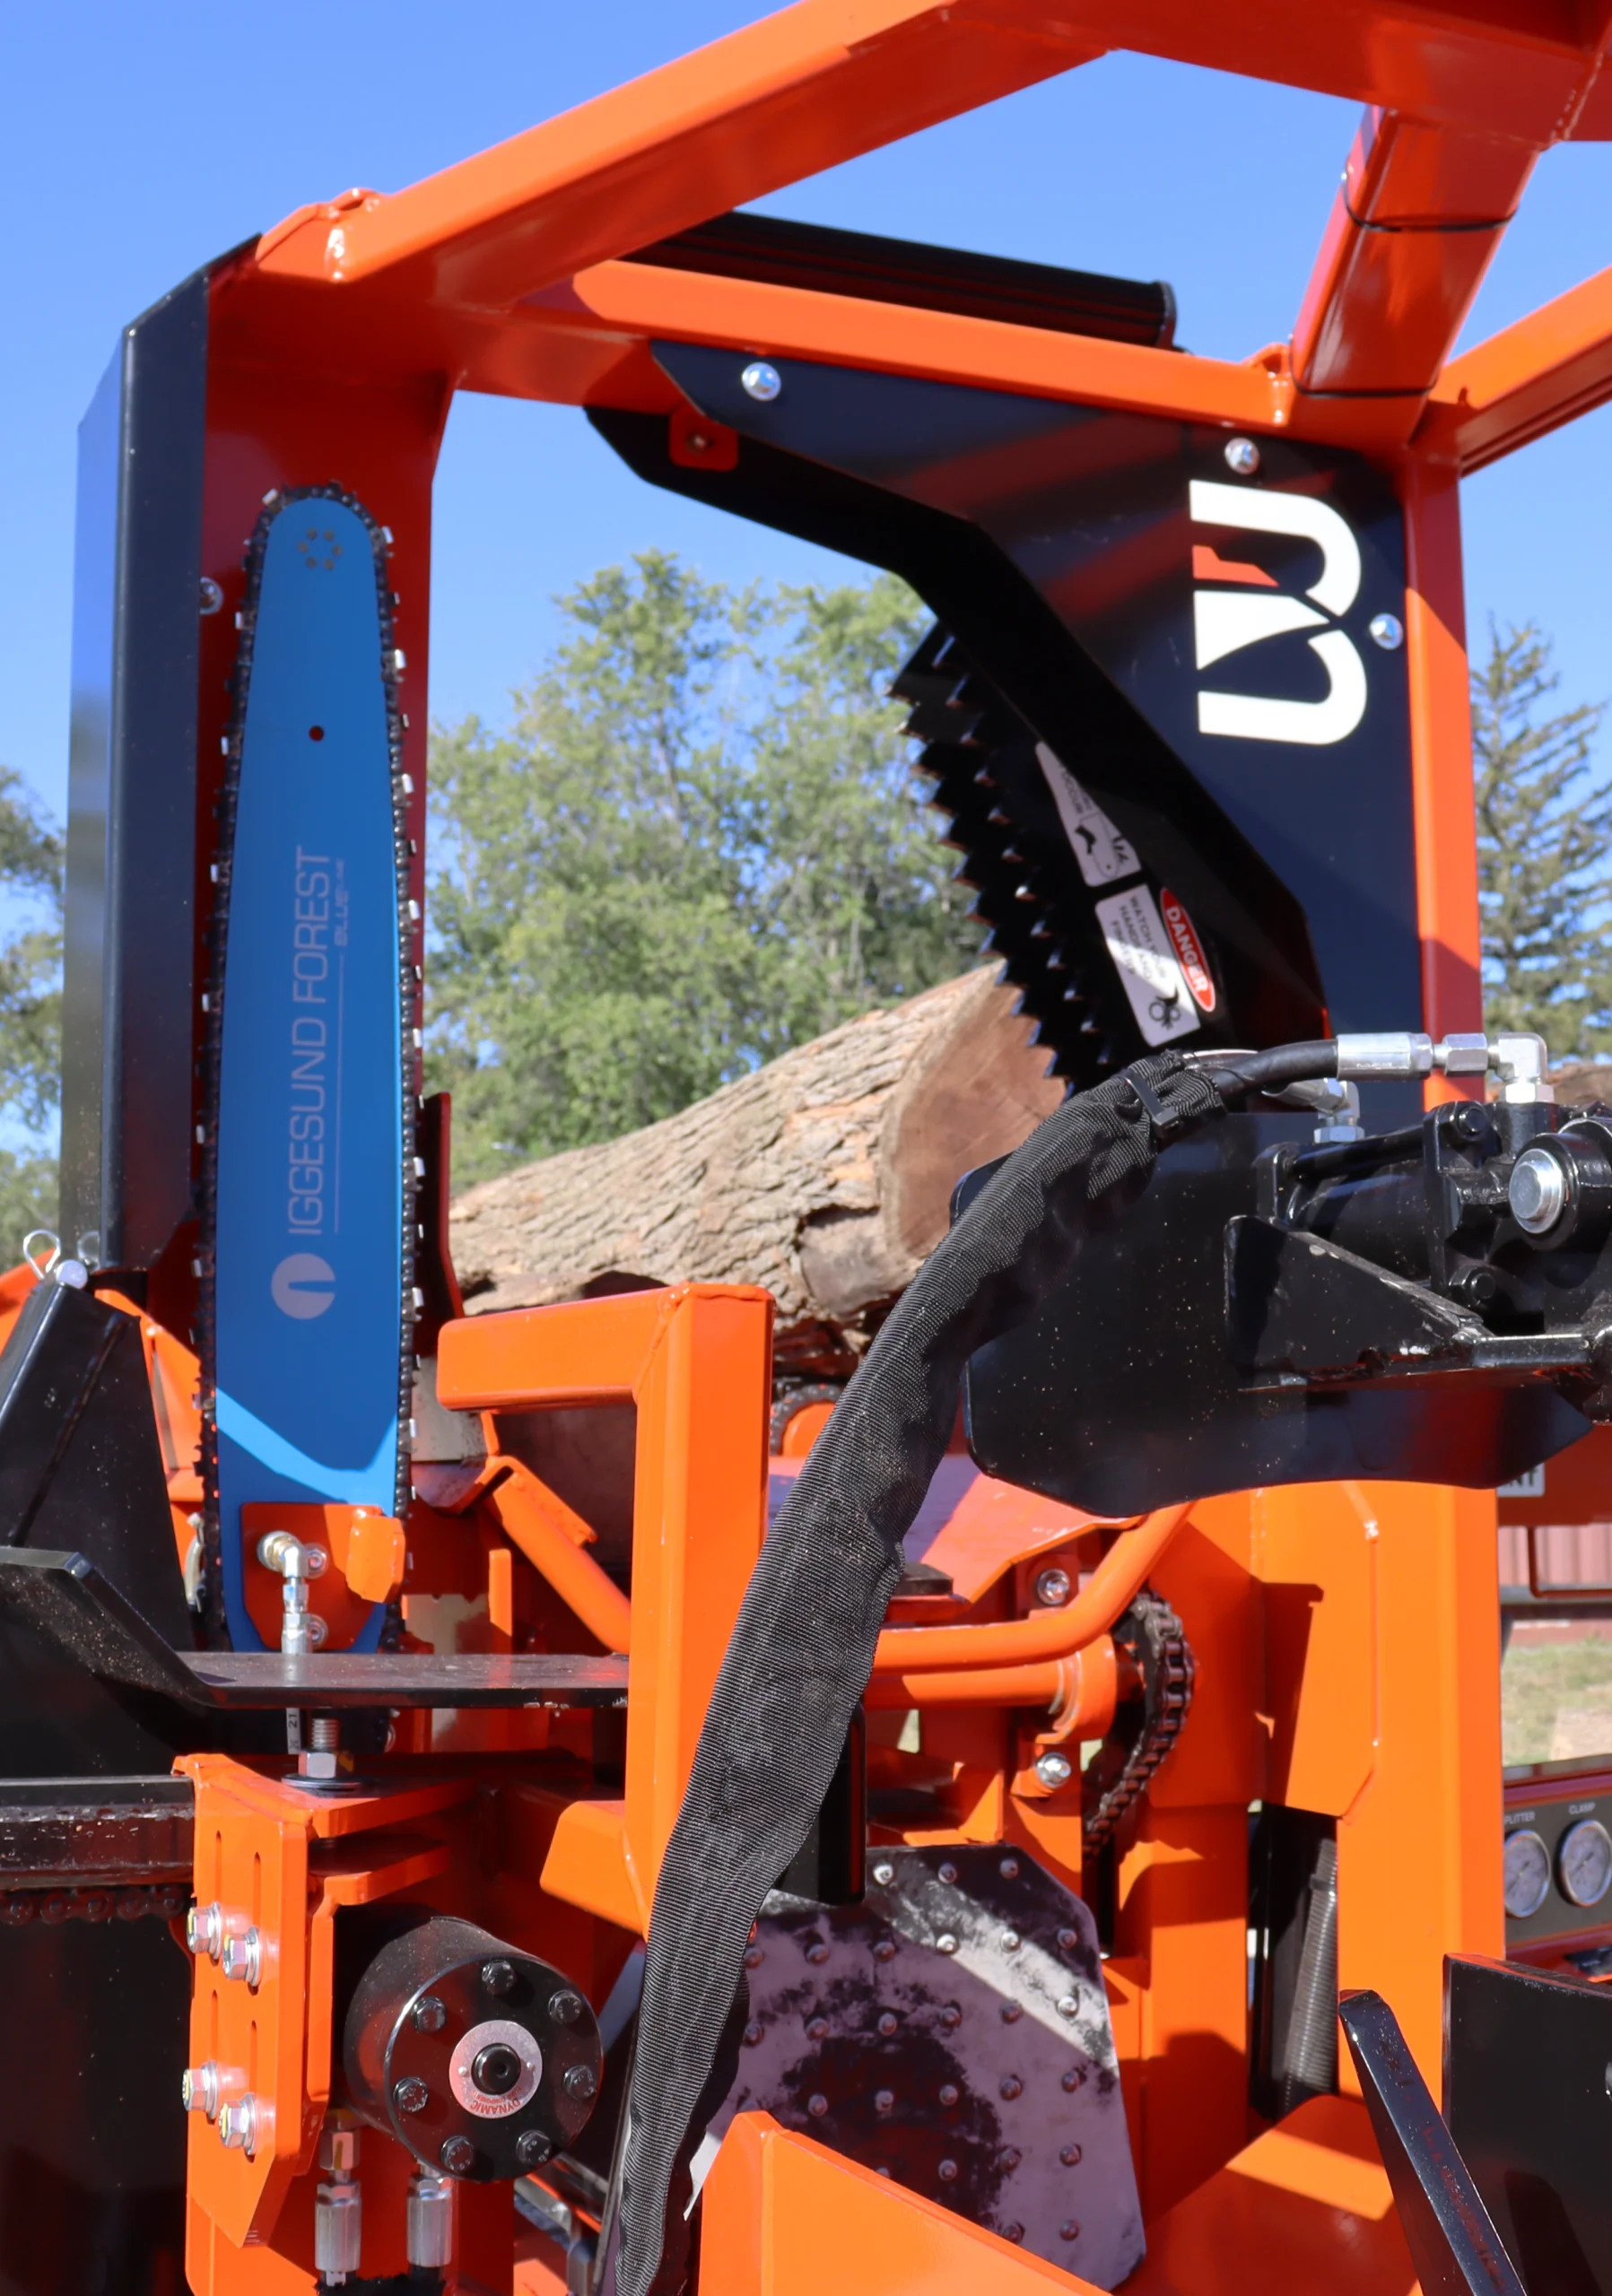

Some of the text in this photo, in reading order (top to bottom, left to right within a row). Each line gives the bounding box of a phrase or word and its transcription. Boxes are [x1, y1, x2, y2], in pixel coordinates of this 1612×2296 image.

[1129, 895, 1153, 943] WATCH
[1165, 906, 1209, 993] DANGER
[288, 845, 331, 1235] IGGESUND FOREST
[1503, 1811, 1535, 1824] PLITTER
[1568, 1802, 1596, 1814] CLAMP
[470, 2098, 520, 2115] DYNAMIC
